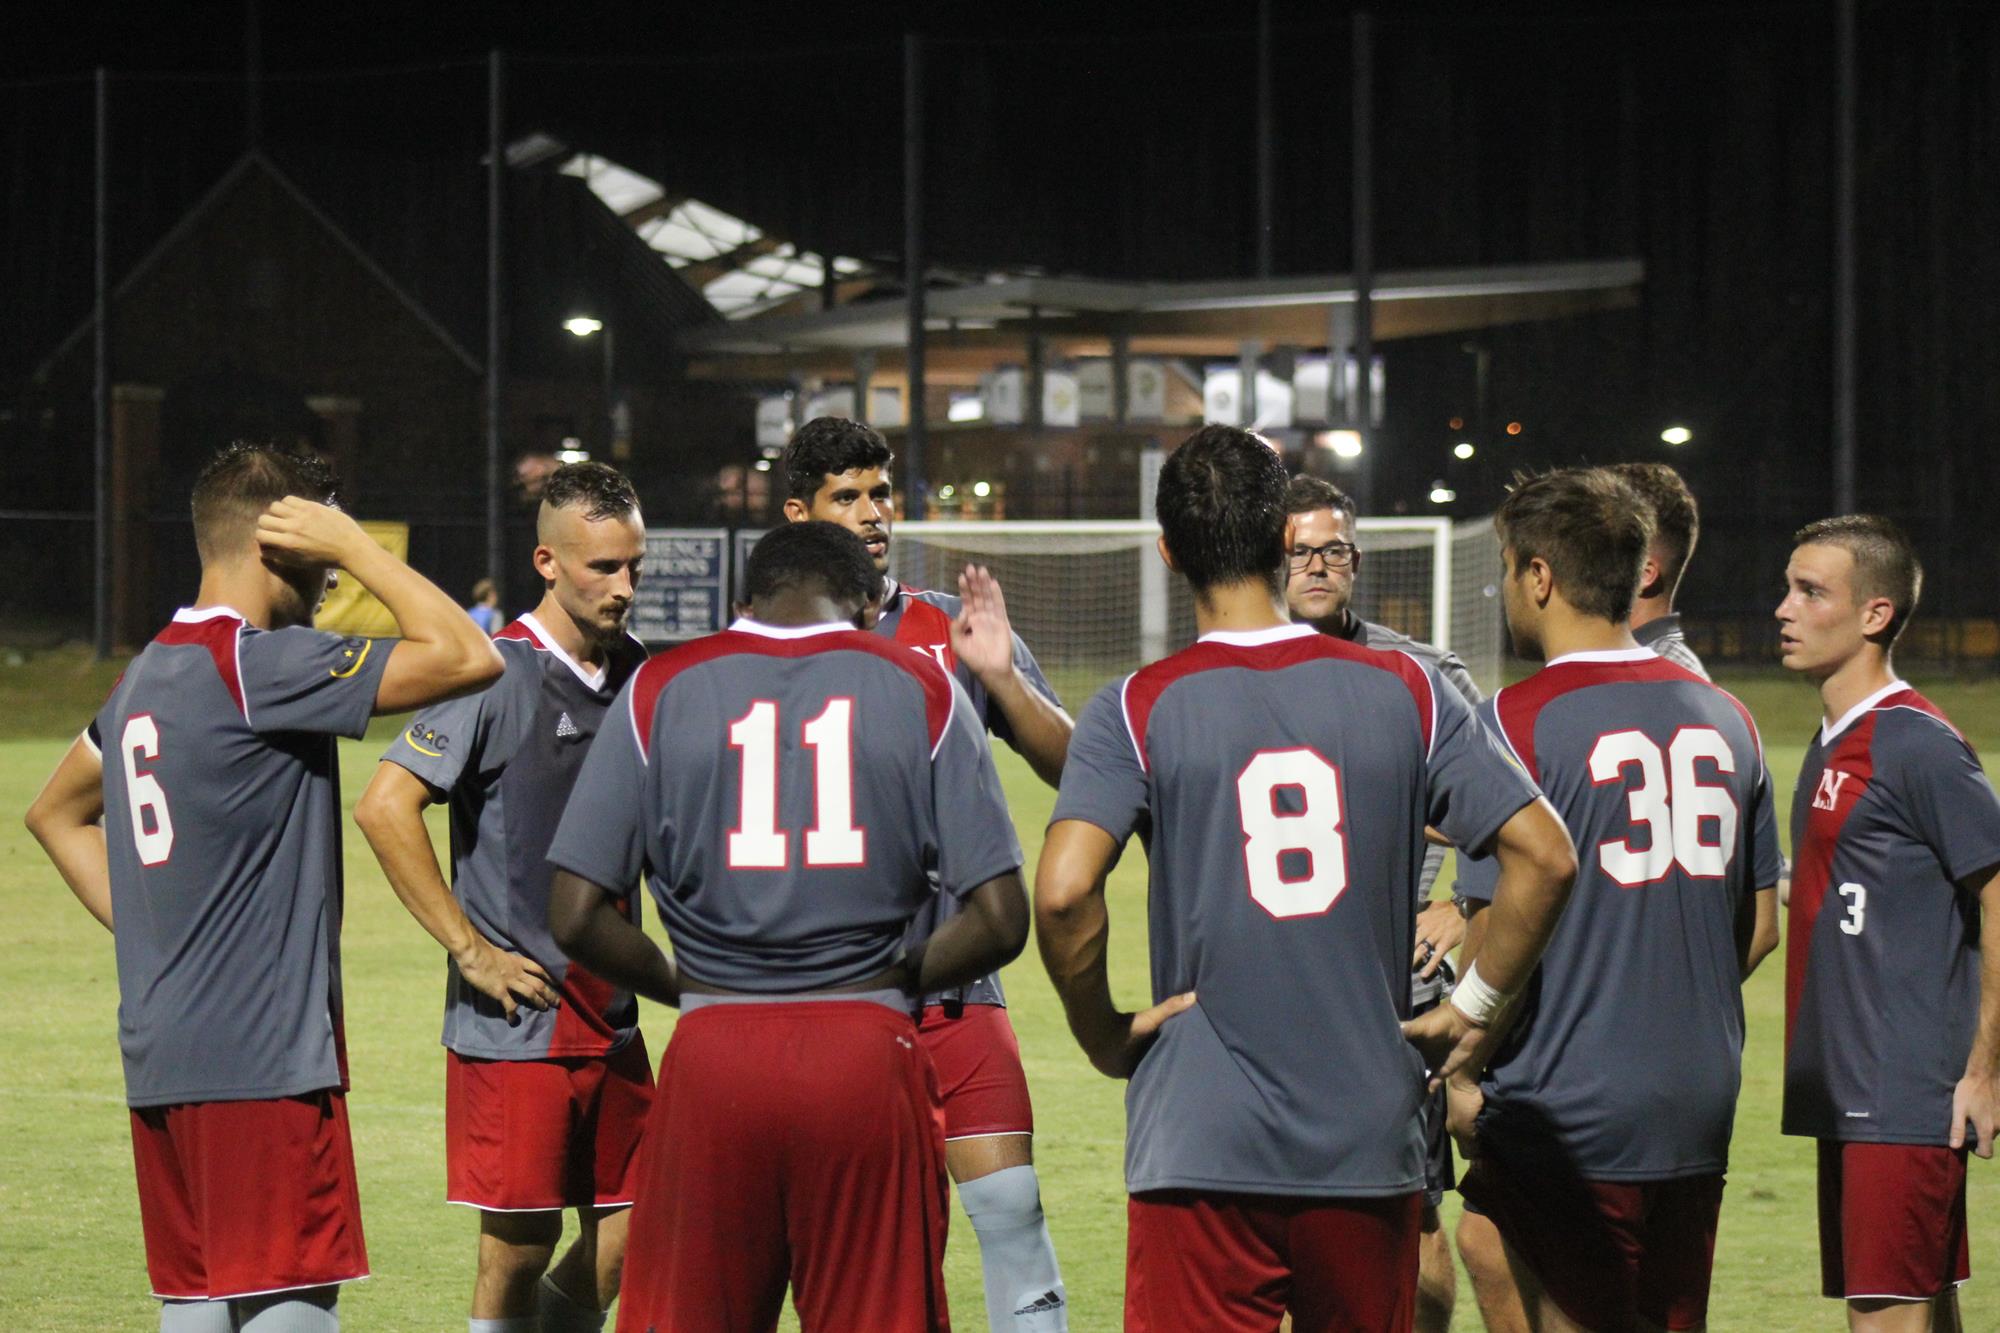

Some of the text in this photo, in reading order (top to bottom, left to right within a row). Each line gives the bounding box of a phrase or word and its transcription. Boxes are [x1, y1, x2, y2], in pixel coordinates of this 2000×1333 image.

[119, 713, 176, 868] 6
[411, 723, 450, 750] SAC
[728, 697, 866, 869] 11
[1588, 726, 1738, 886] 36
[1236, 746, 1349, 921] 8
[1838, 881, 1867, 936] 3
